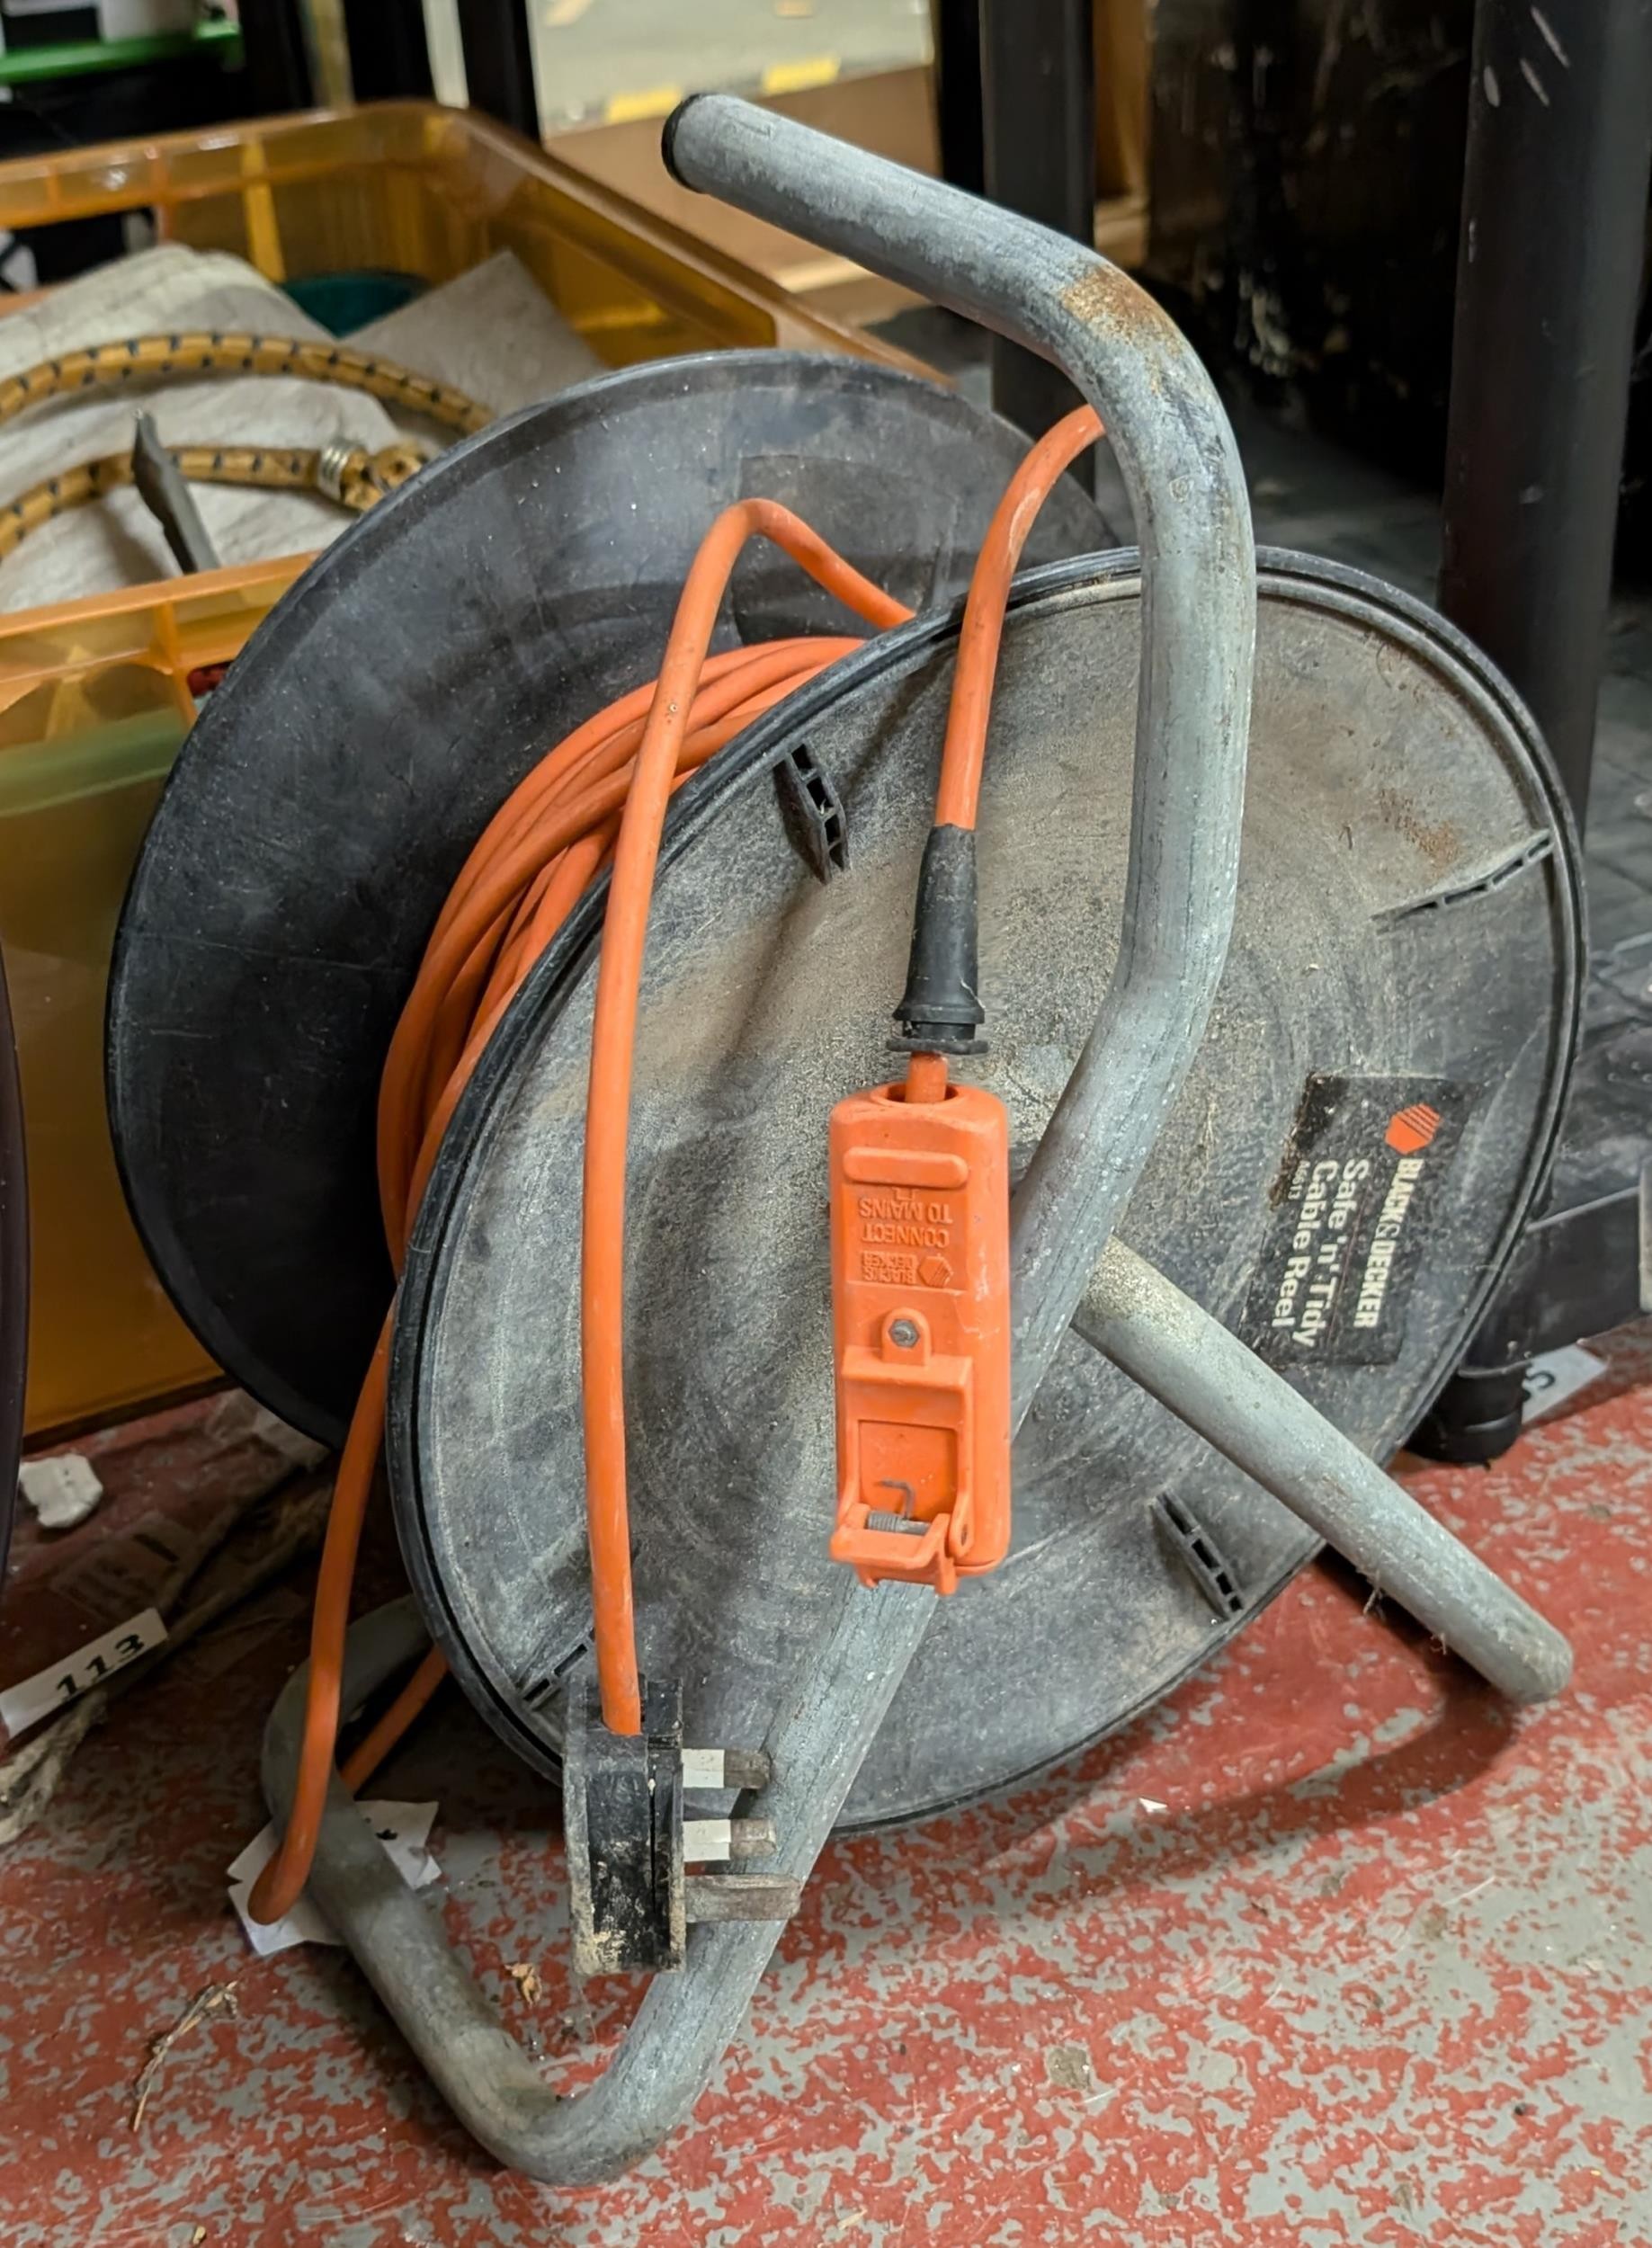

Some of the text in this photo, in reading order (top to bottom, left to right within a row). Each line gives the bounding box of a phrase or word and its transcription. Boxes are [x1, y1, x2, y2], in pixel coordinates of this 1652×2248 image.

[858, 1197, 954, 1225] TO MAINS
[1328, 1159, 1370, 1231] Safe
[862, 1223, 951, 1249] CONNECT
[862, 1250, 918, 1270] DECKER
[1272, 1160, 1339, 1328] Cable Reel
[1292, 1277, 1338, 1348] Tidy
[55, 1633, 145, 1699] 113
